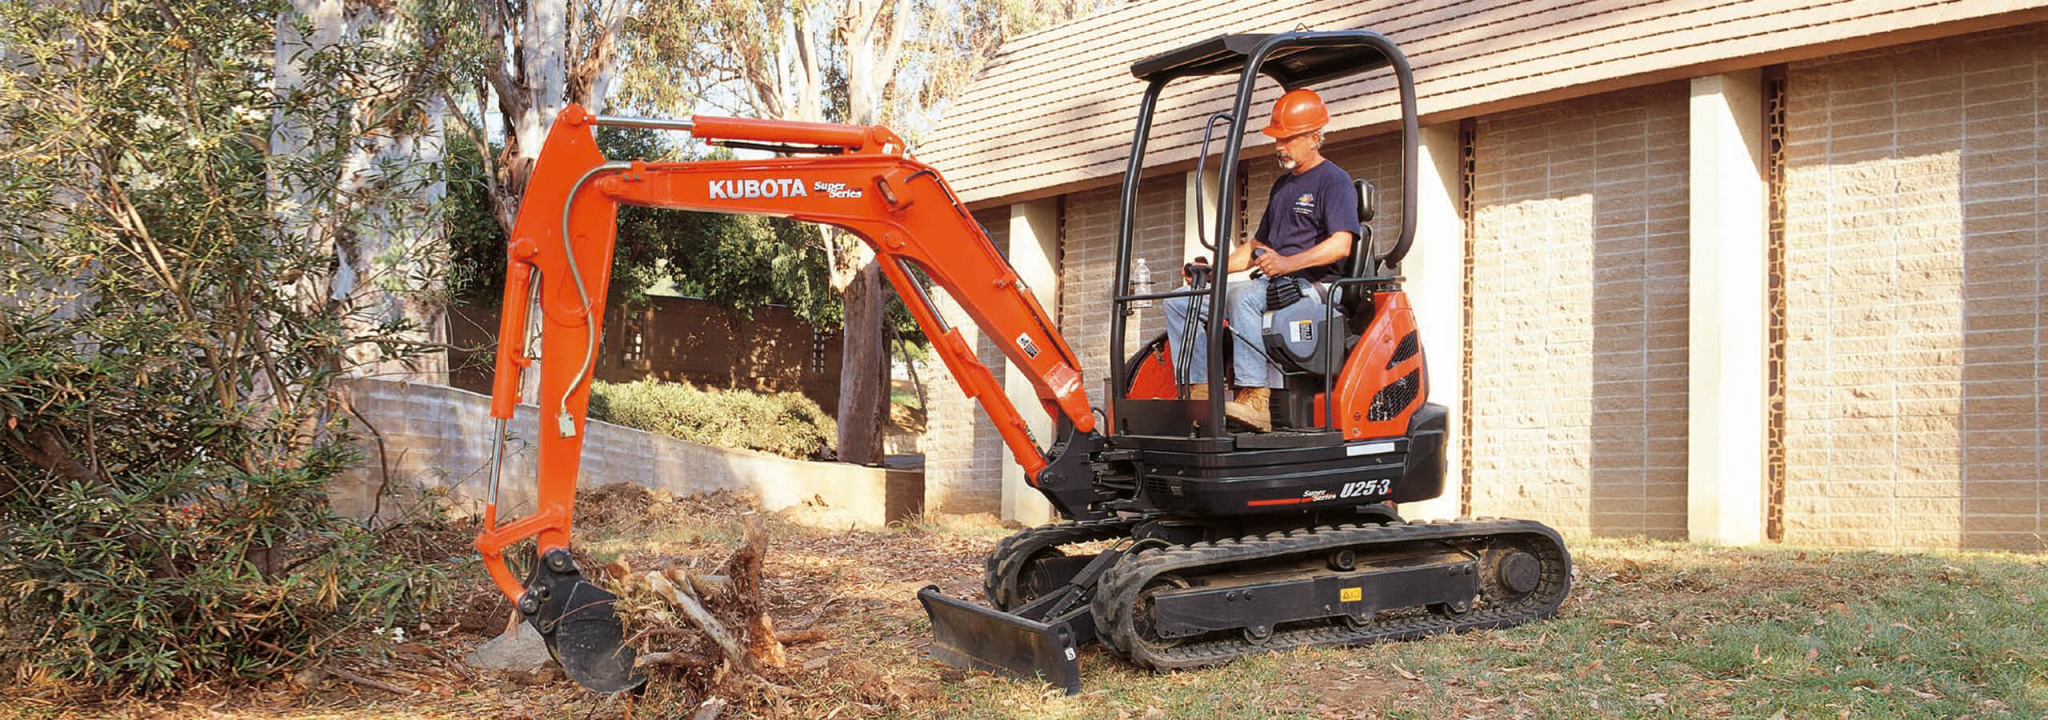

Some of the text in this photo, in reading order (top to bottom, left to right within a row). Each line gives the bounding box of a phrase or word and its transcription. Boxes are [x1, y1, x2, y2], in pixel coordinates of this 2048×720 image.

[709, 179, 807, 199] KUBOTA
[814, 181, 846, 192] Super
[829, 189, 862, 198] Series
[1340, 479, 1391, 498] U25-3
[1303, 490, 1326, 498] Super
[1313, 493, 1337, 502] Series
